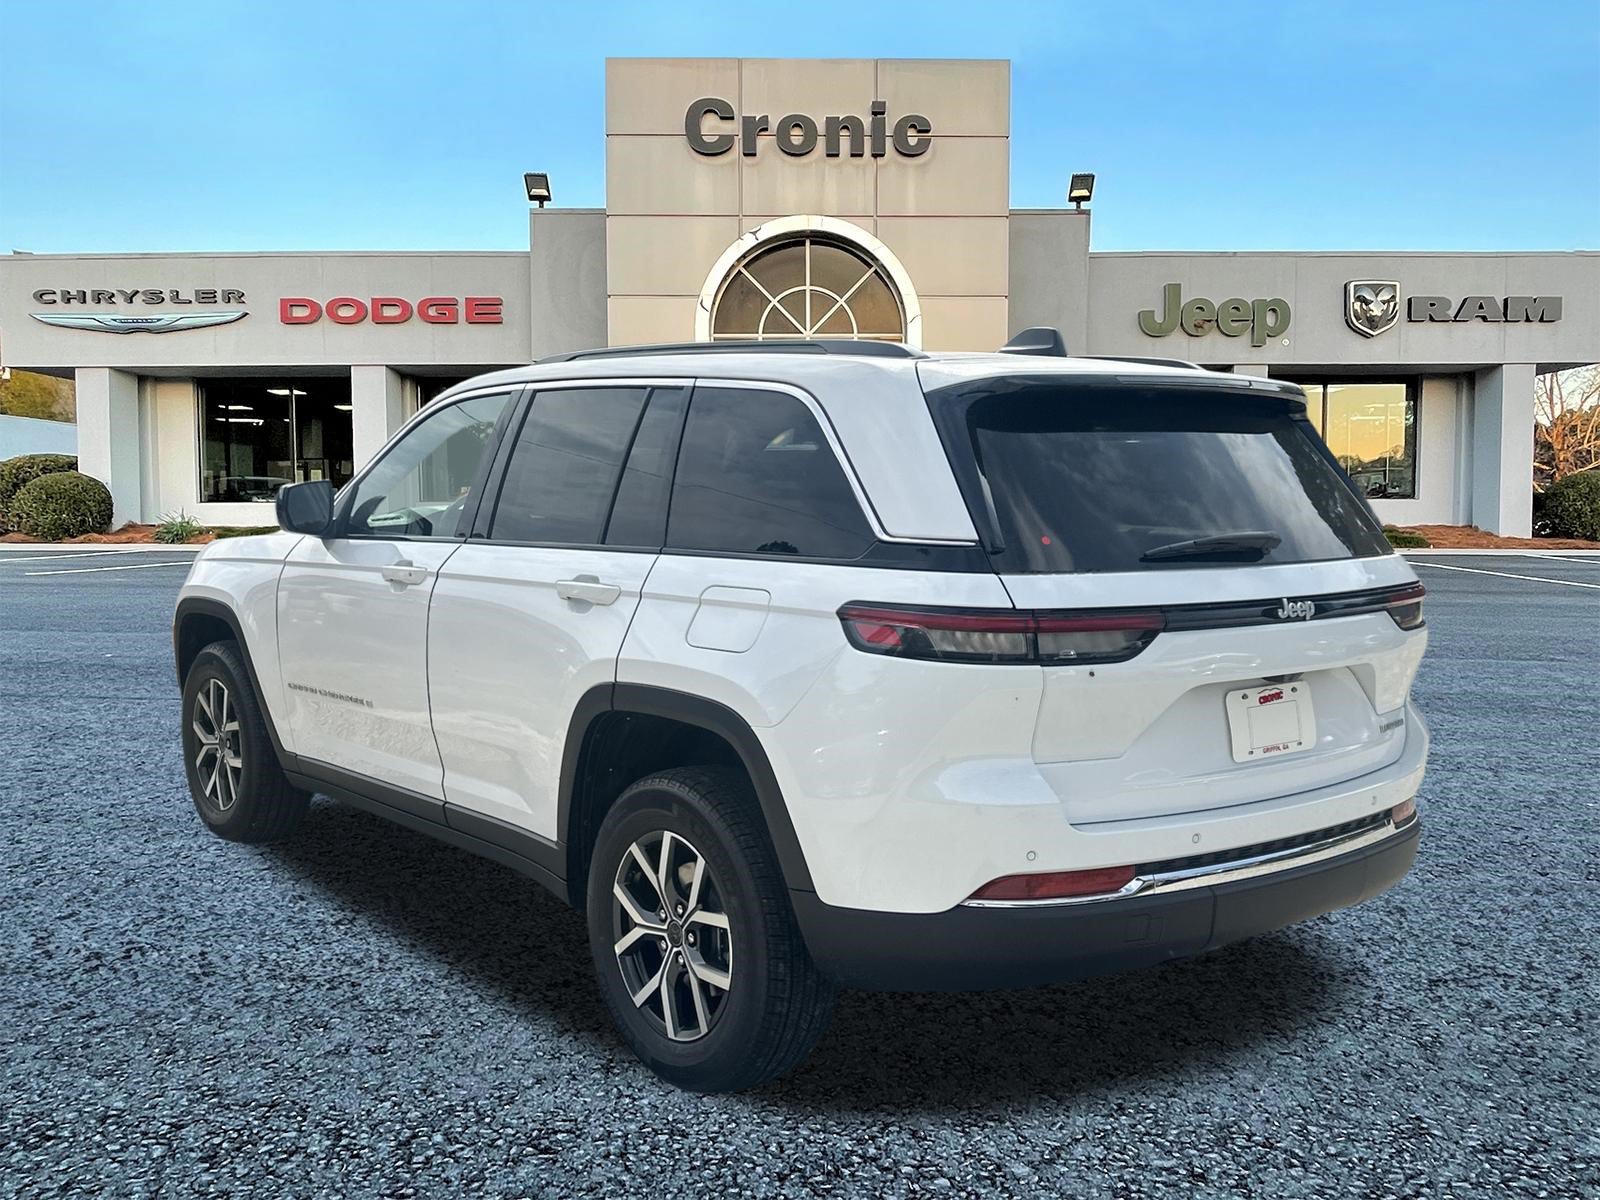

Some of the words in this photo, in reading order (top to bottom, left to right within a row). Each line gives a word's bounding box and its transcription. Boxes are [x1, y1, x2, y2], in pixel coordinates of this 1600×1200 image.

[685, 97, 931, 157] Cronic
[33, 288, 247, 304] CHRYSLER
[1407, 296, 1563, 322] RAM
[280, 297, 503, 325] DODGE
[1138, 283, 1291, 347] Jeep
[1277, 598, 1315, 620] Jeep
